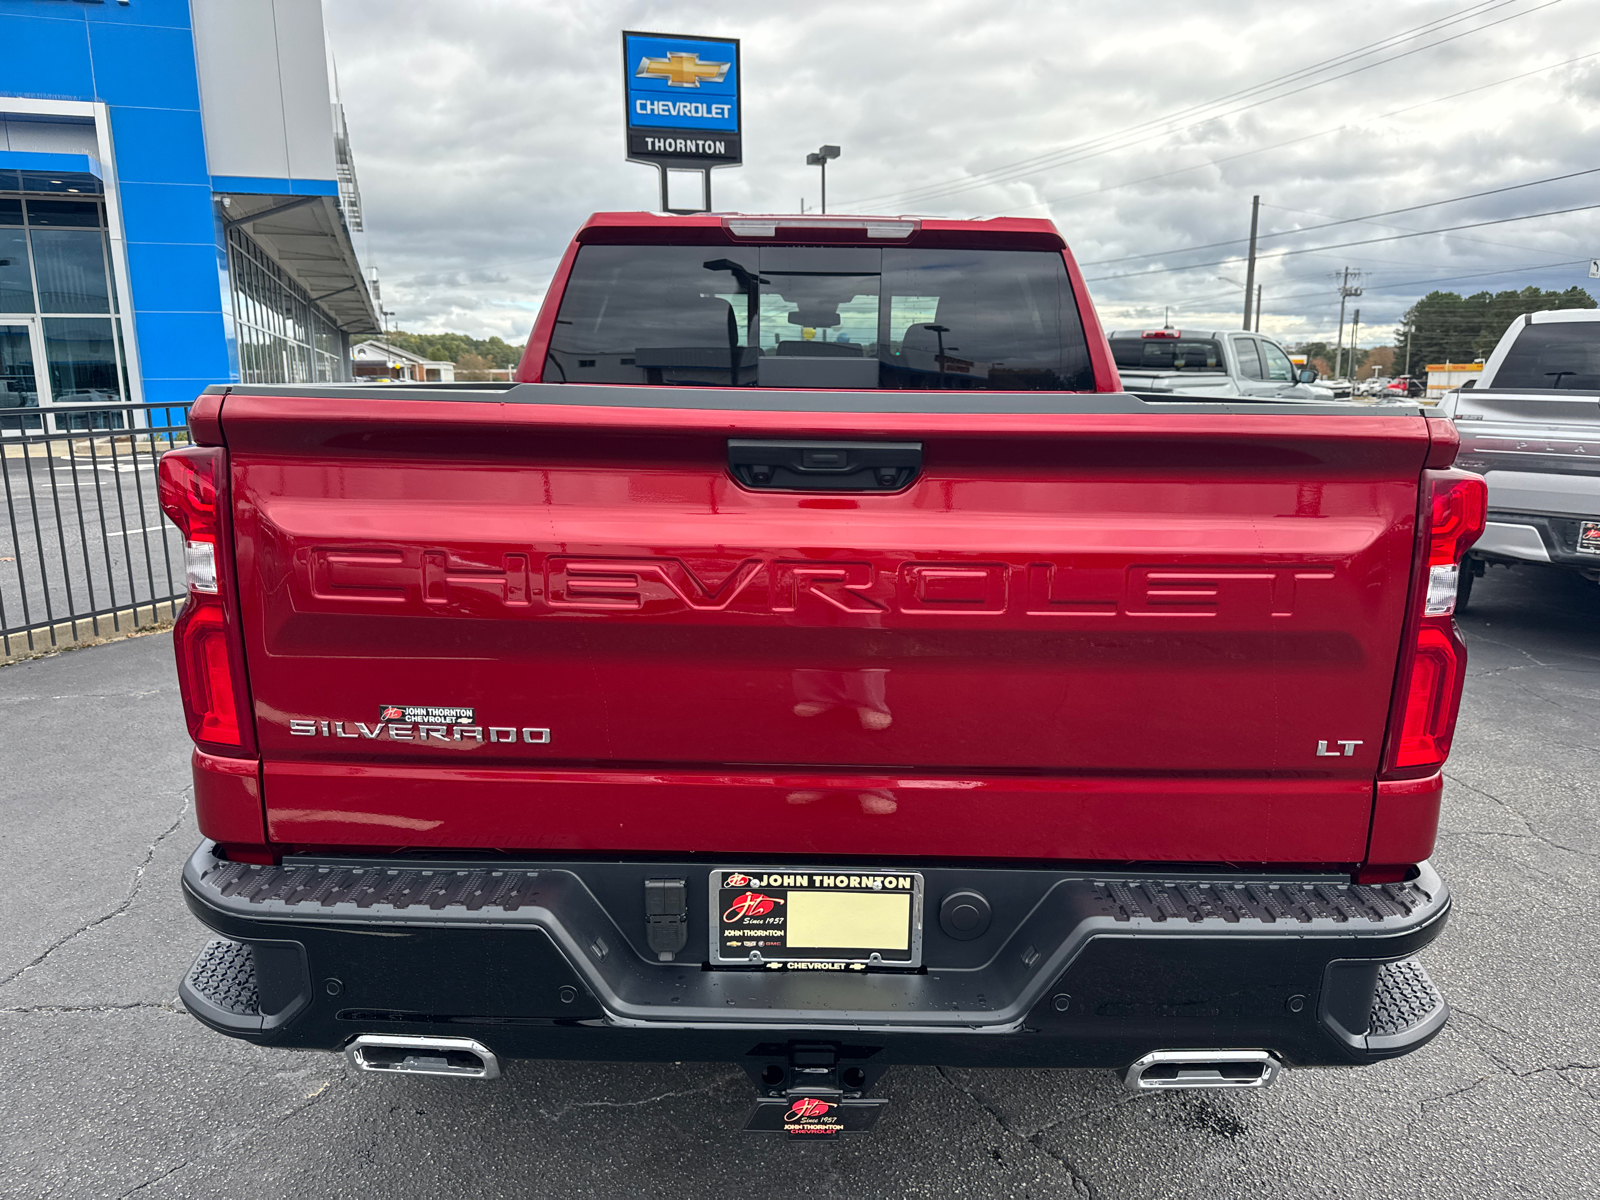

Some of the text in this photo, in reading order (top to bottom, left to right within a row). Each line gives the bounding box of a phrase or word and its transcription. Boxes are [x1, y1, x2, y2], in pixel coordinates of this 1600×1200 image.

[636, 99, 731, 118] CHEVROLET
[645, 137, 725, 154] THORNTON
[308, 546, 1336, 617] CHEVROLET
[405, 707, 473, 717] JOHN THORNTON
[405, 715, 457, 724] CHEVROLET
[289, 719, 550, 744] SILVERADO
[1316, 740, 1364, 756] LT
[760, 874, 809, 887] JOHN
[812, 875, 911, 889] THORNTON
[743, 917, 785, 925] Since 1957
[786, 962, 846, 970] CHEVROLET
